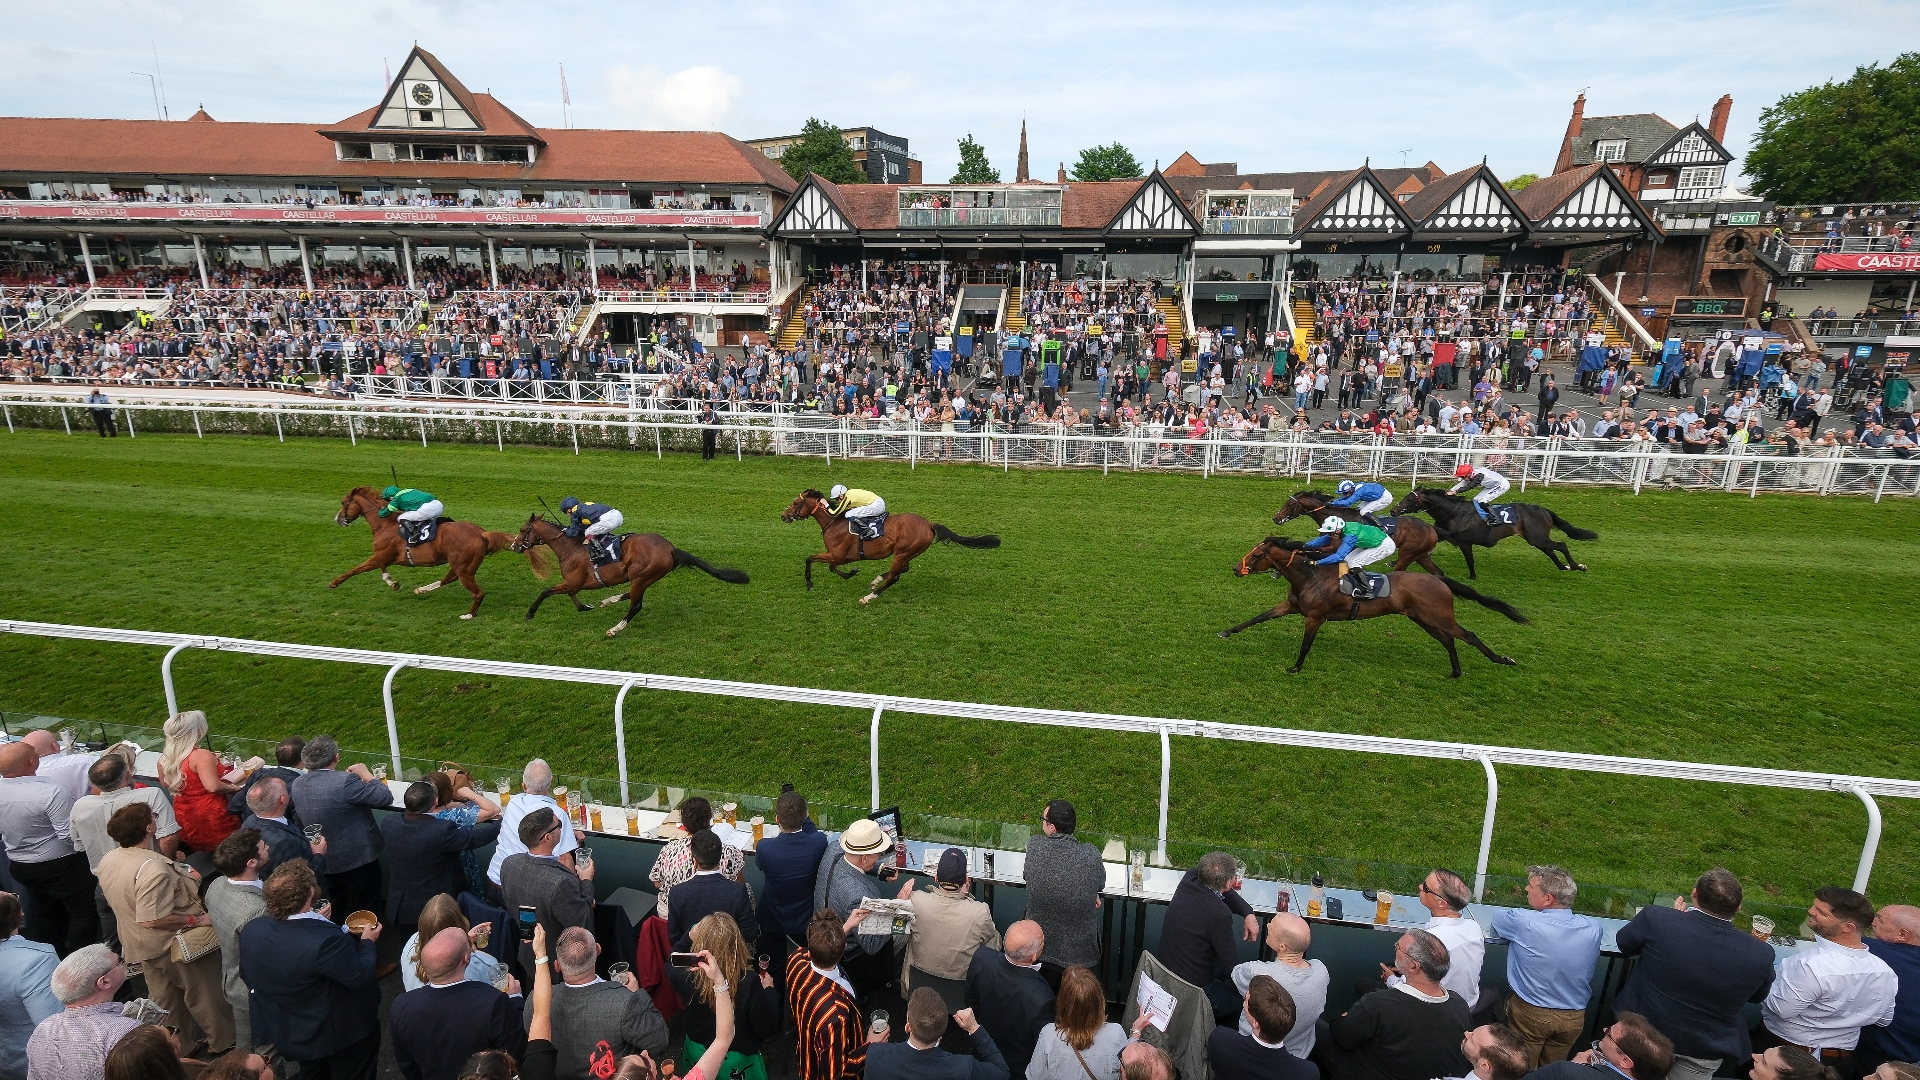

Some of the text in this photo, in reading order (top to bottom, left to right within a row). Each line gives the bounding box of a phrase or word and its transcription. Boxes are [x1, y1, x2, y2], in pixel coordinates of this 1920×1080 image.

[1731, 214, 1758, 223] EXIT
[1696, 304, 1723, 315] BBQ
[1500, 510, 1513, 524] 2
[420, 523, 431, 541] 5
[605, 542, 617, 560] 1
